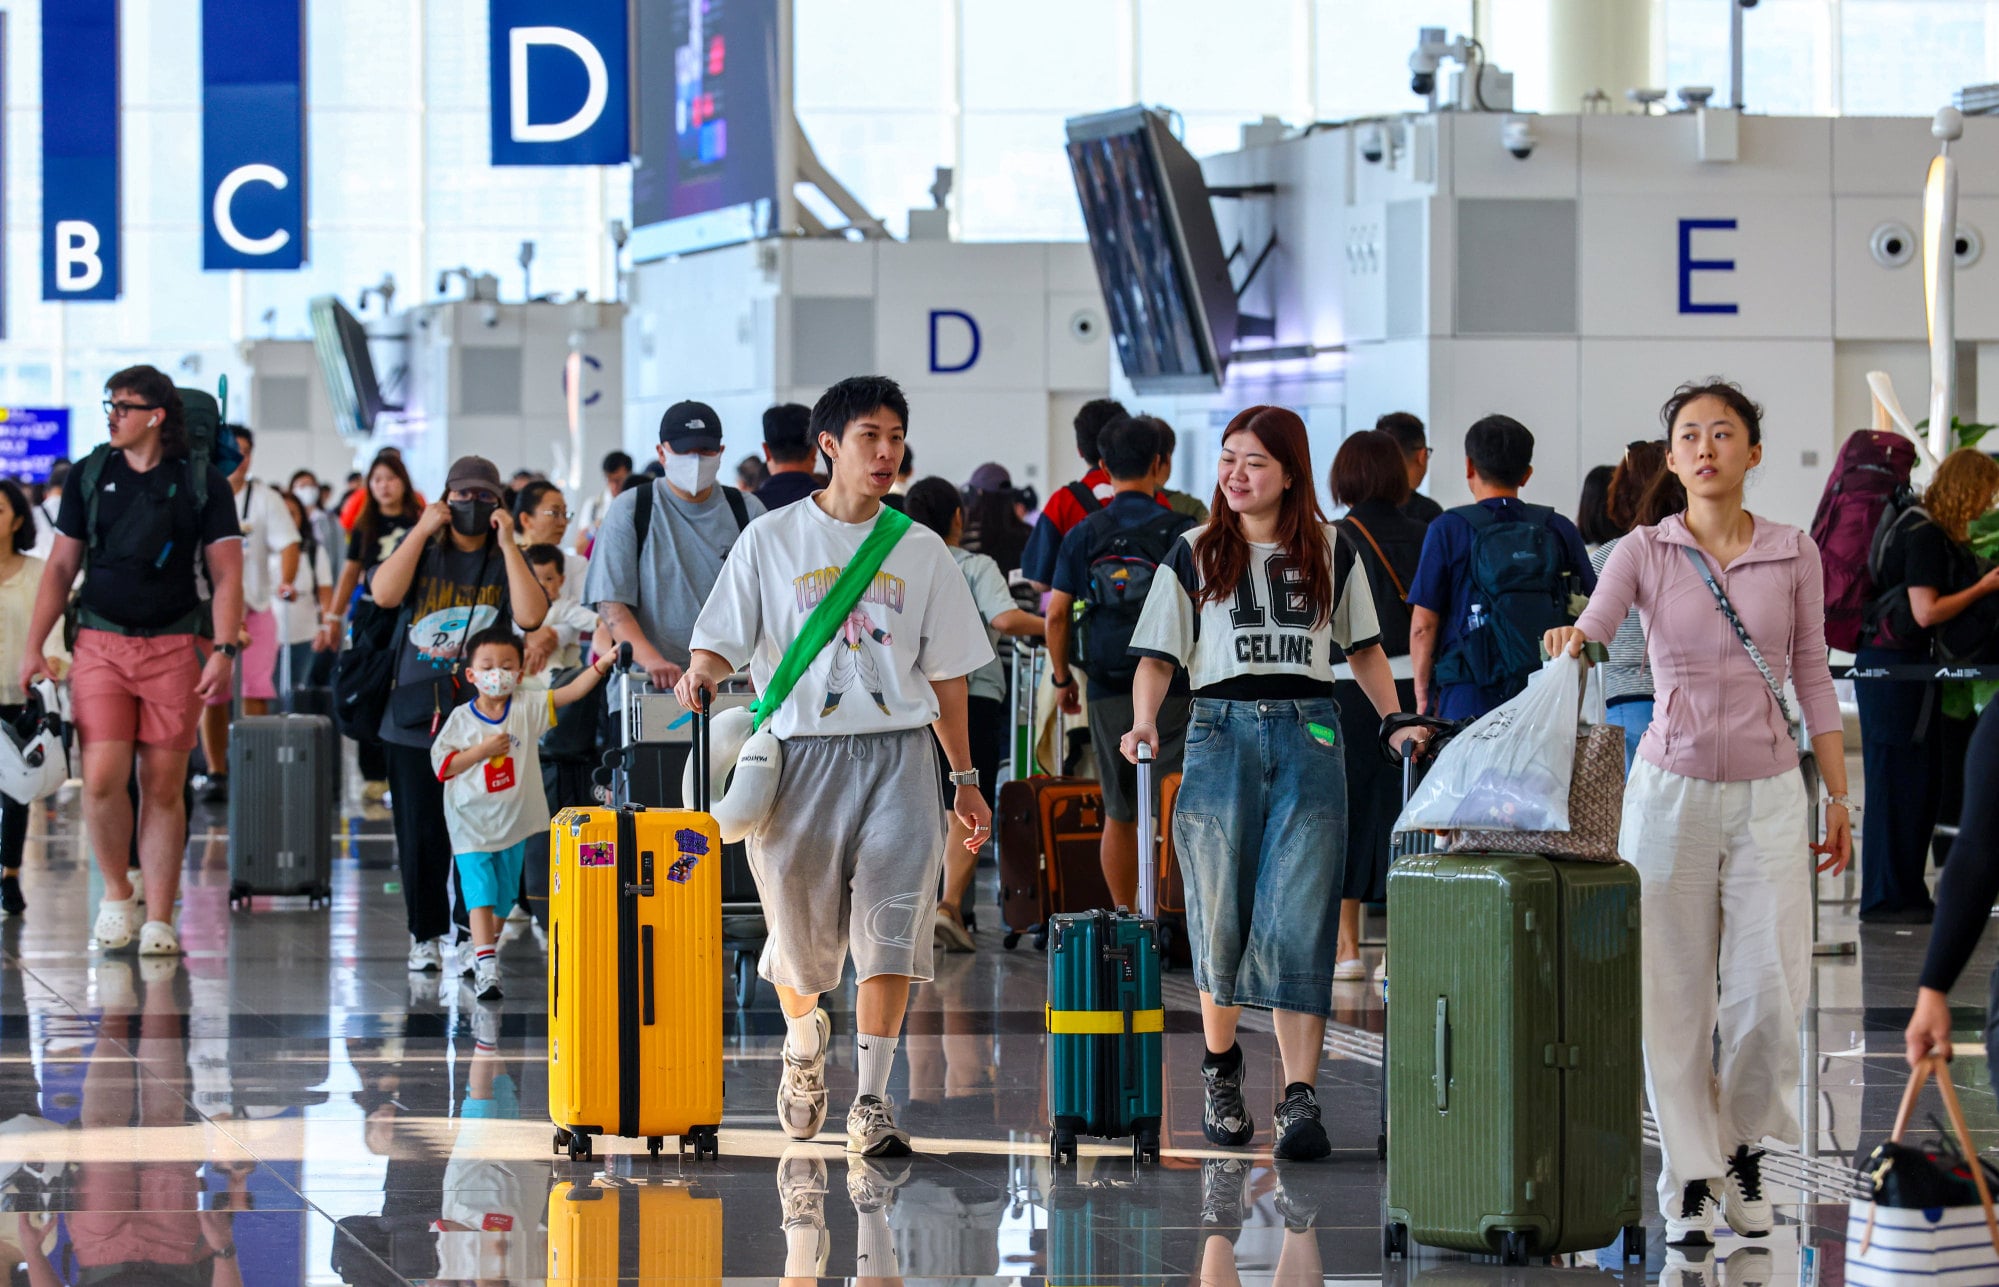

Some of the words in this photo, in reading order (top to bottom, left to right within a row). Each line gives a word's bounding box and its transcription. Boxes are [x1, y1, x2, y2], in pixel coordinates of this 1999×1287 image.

[509, 26, 608, 142] D
[213, 163, 290, 255] C
[56, 220, 102, 292] B
[1678, 218, 1738, 314] E
[930, 309, 981, 373] D
[1235, 634, 1313, 667] CELINE
